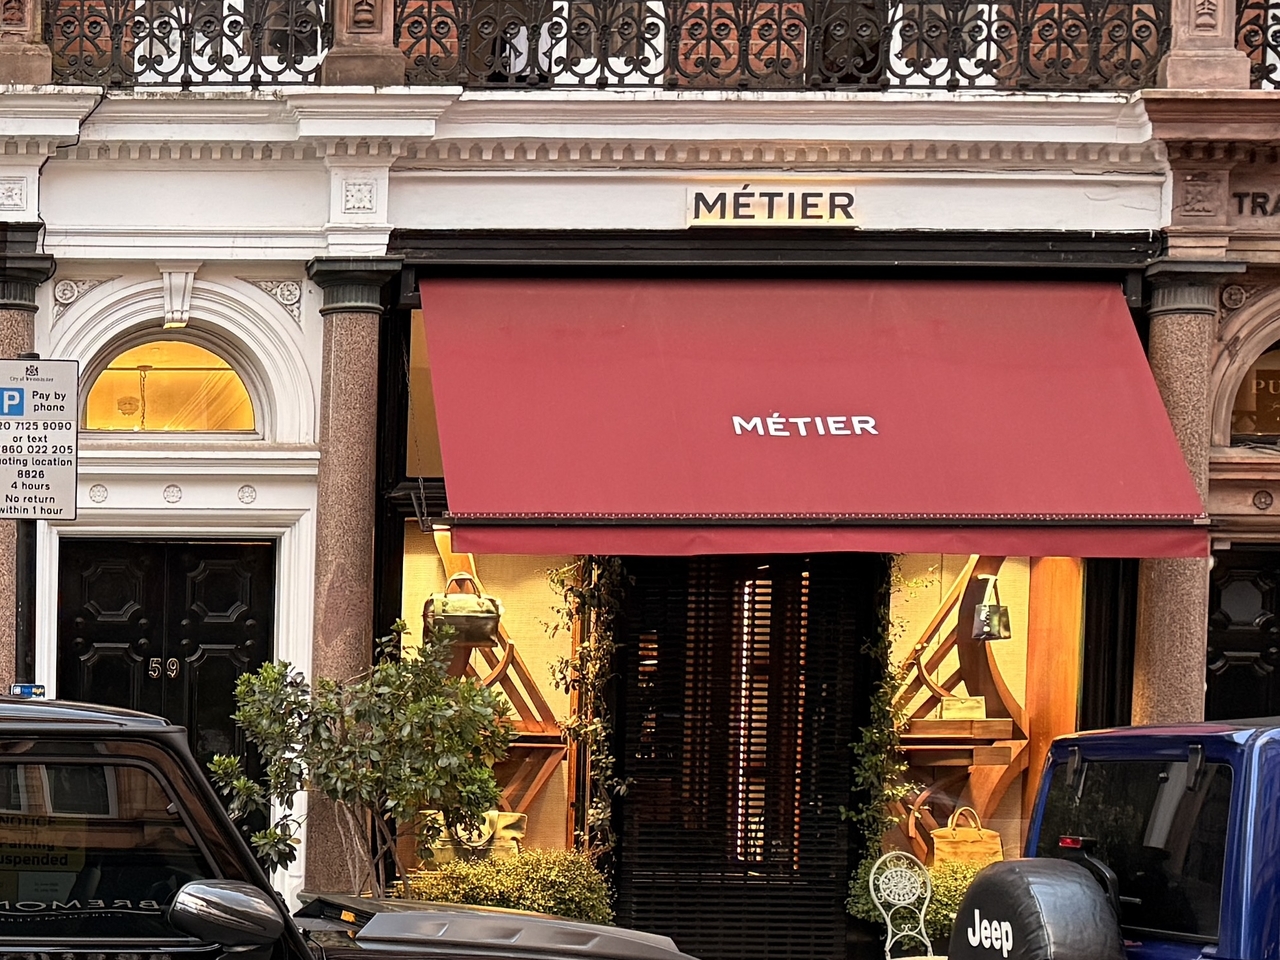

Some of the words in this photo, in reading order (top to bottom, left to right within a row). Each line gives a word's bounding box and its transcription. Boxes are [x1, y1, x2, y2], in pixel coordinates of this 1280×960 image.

[693, 183, 855, 220] MÉTIER
[32, 391, 51, 402] Pay
[54, 391, 67, 402] by
[3, 390, 20, 414] P
[33, 402, 65, 413] phone
[15, 421, 39, 431] 7125
[42, 421, 72, 431] 9090
[731, 412, 880, 437] MÉTIER
[12, 435, 23, 443] or
[27, 434, 48, 443] text
[27, 445, 48, 454] 022
[51, 445, 73, 454] 205
[31, 457, 73, 467] location
[17, 470, 45, 479] 8826
[11, 481, 18, 490] 4
[21, 481, 51, 491] hours
[5, 494, 20, 503] No
[23, 494, 56, 504] return
[40, 506, 63, 515] hour
[148, 657, 180, 679] 59
[0, 836, 55, 852] Parking
[967, 908, 1014, 958] Jeep
